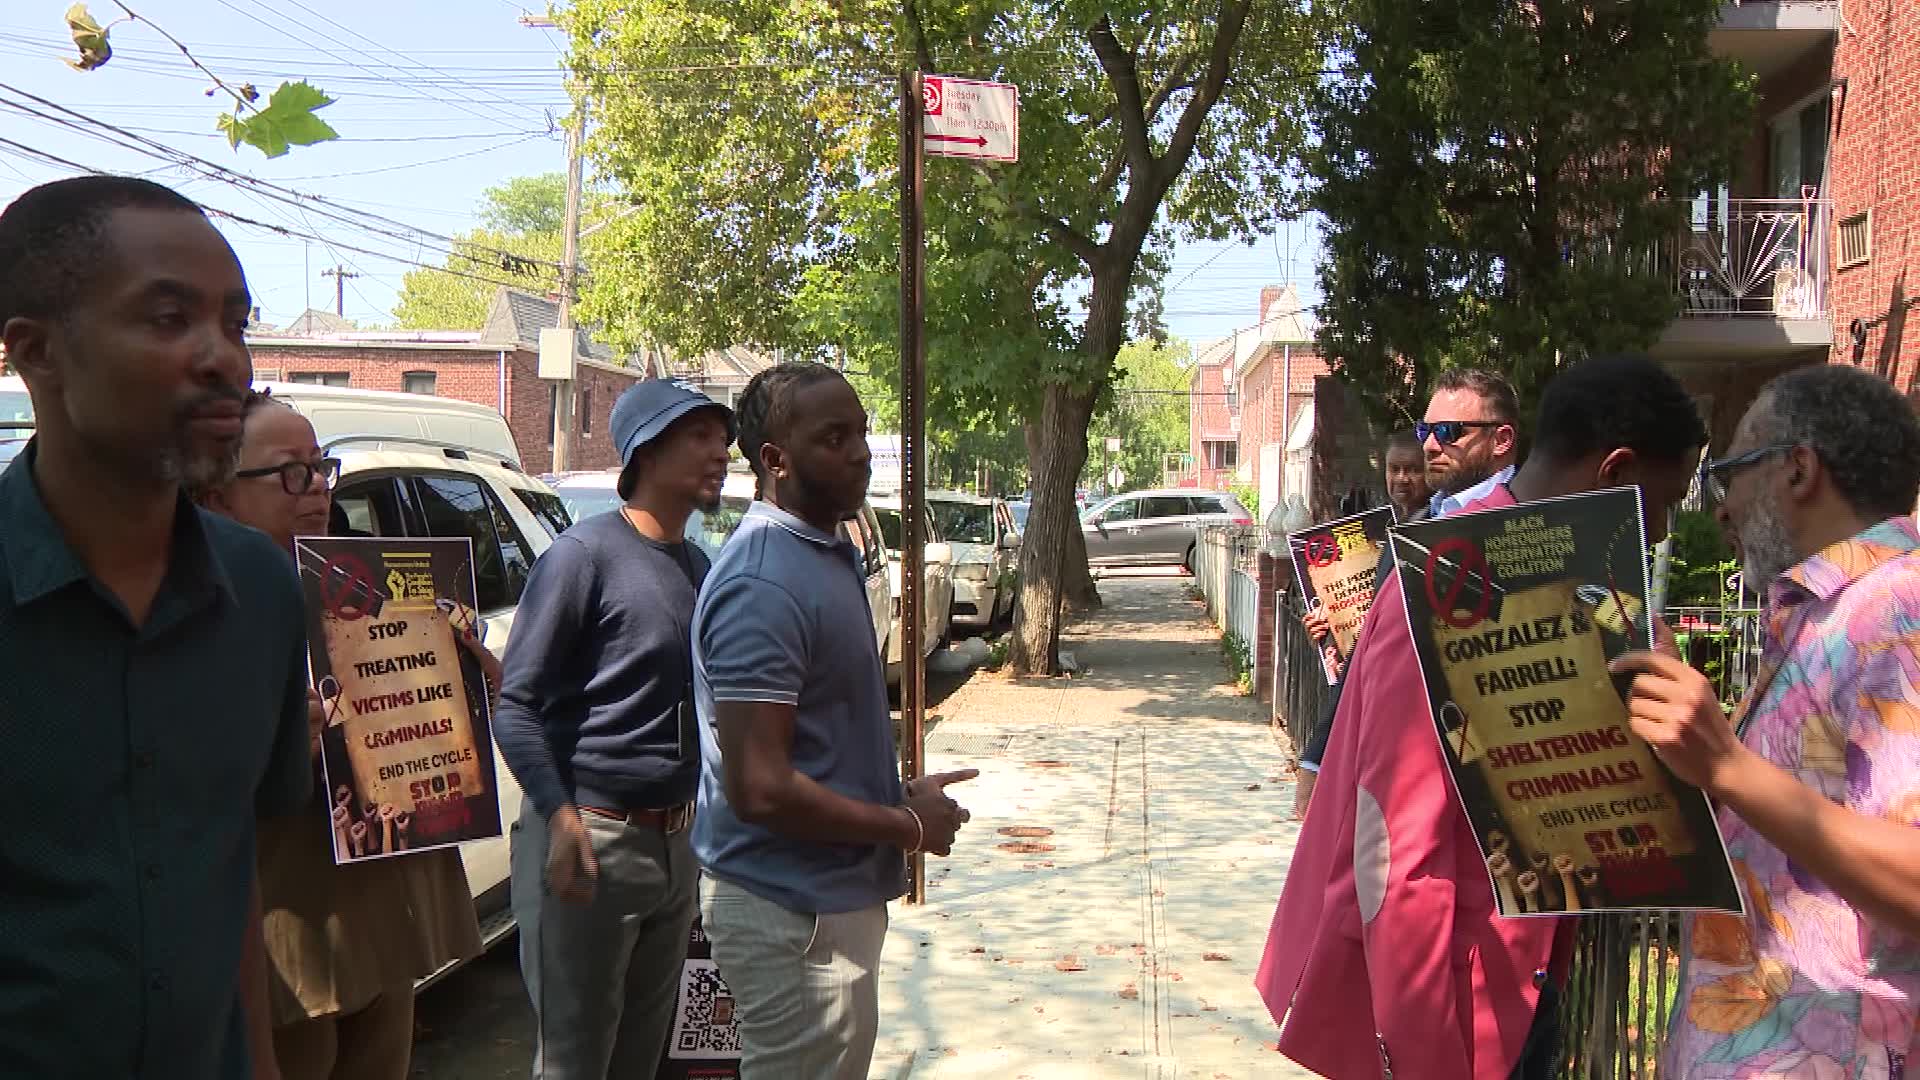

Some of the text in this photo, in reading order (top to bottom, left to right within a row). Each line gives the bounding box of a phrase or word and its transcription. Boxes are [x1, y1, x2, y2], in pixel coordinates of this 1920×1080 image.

[946, 101, 972, 113] Friday
[947, 89, 981, 102] Tuesday
[946, 116, 966, 128] 11am
[1504, 514, 1545, 534] BLACK
[1485, 540, 1576, 566] PRESERVATION
[1347, 567, 1377, 586] PEOP
[1497, 557, 1565, 579] COALITION
[1334, 579, 1375, 601] DEMAN
[368, 621, 408, 640] STOP
[1444, 615, 1568, 664] GONZALEZ
[353, 651, 437, 678] TREATING
[1474, 656, 1579, 696] FARRELL:
[352, 683, 453, 716] VICTIMS LIKE
[1508, 698, 1566, 728] STOP
[364, 718, 453, 750] CRIMINALS!
[1486, 725, 1630, 770] SHELTERING
[378, 748, 473, 781] END THE CYCLE
[1505, 759, 1645, 801] CRIMINALS!
[1538, 793, 1666, 828] END THE CYCLE
